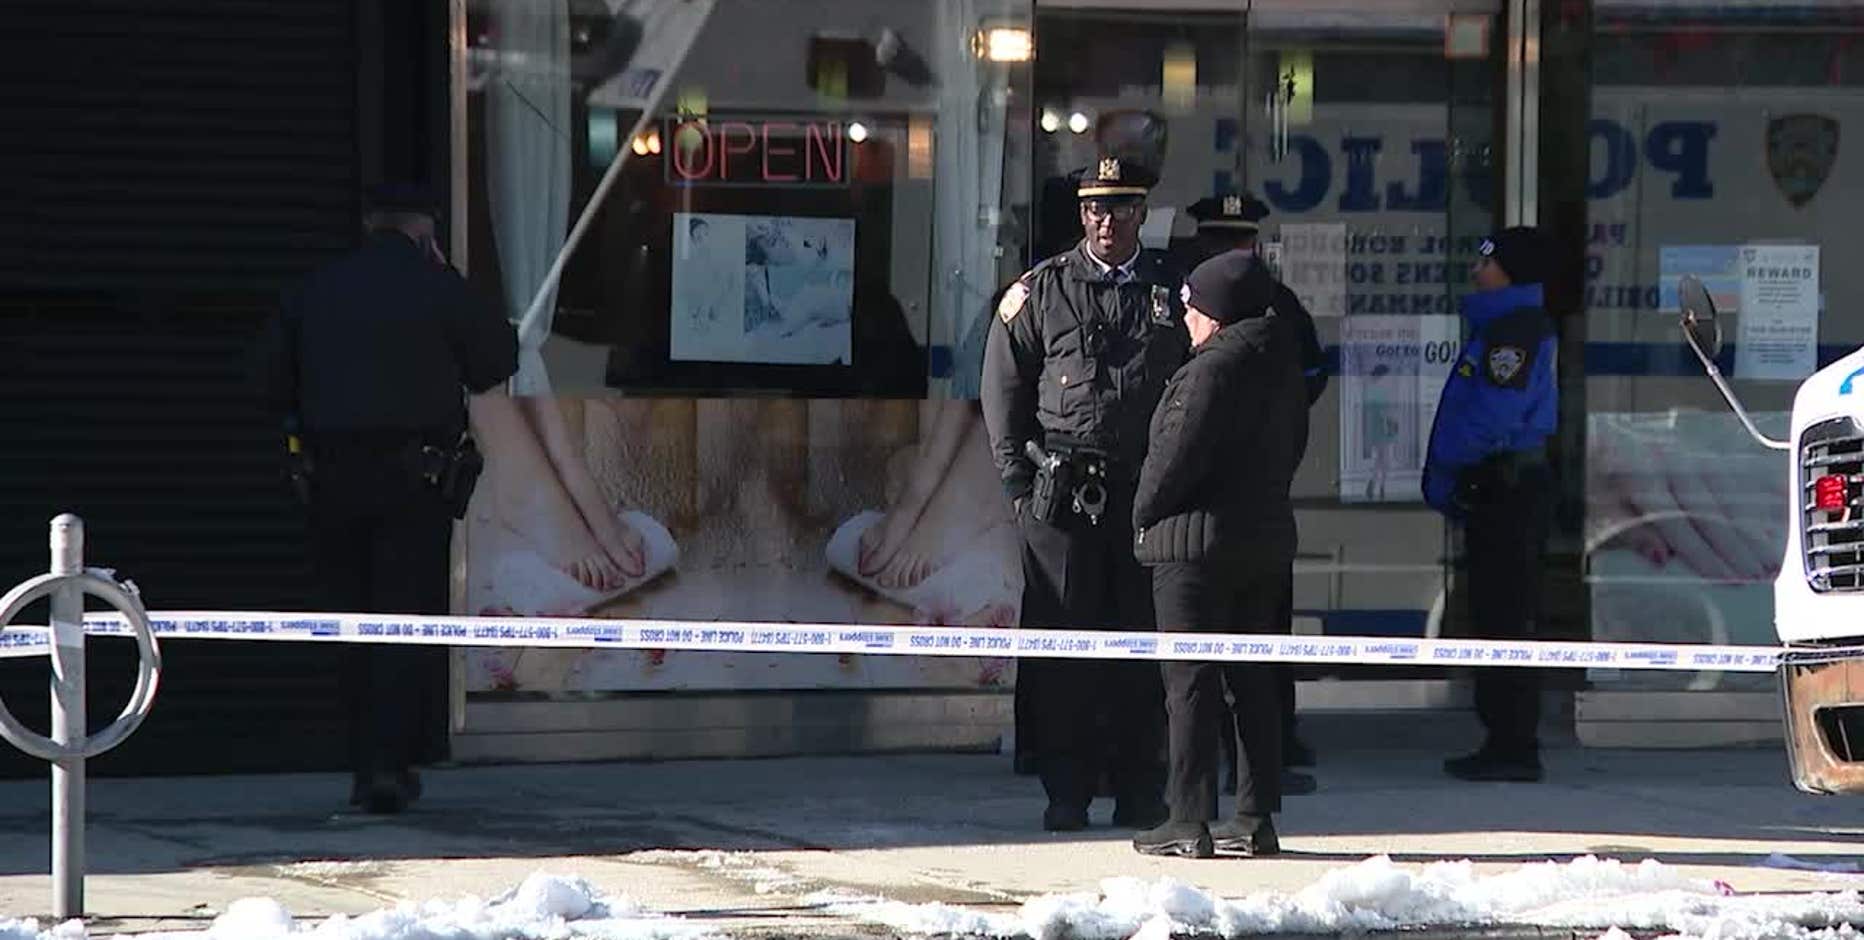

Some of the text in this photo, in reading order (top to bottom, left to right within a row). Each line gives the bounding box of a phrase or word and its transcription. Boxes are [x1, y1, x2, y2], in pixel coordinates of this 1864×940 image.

[674, 121, 842, 180] OPEN
[1746, 267, 1812, 280] REWARD
[1424, 340, 1457, 364] GO!
[358, 623, 384, 635] CROSS
[386, 623, 400, 636] NOT
[402, 624, 414, 636] DO
[422, 624, 438, 636] LINE
[440, 624, 466, 637] POLICE
[640, 629, 664, 641] CROSS
[666, 629, 680, 642] NOT
[682, 630, 692, 642] DO
[700, 630, 718, 643] LINE
[718, 631, 744, 643] POLICE
[910, 635, 934, 648] CROSS
[934, 636, 950, 648] NOT
[950, 636, 962, 648] DO
[968, 637, 986, 649] LINE
[986, 637, 1012, 650] POLICE
